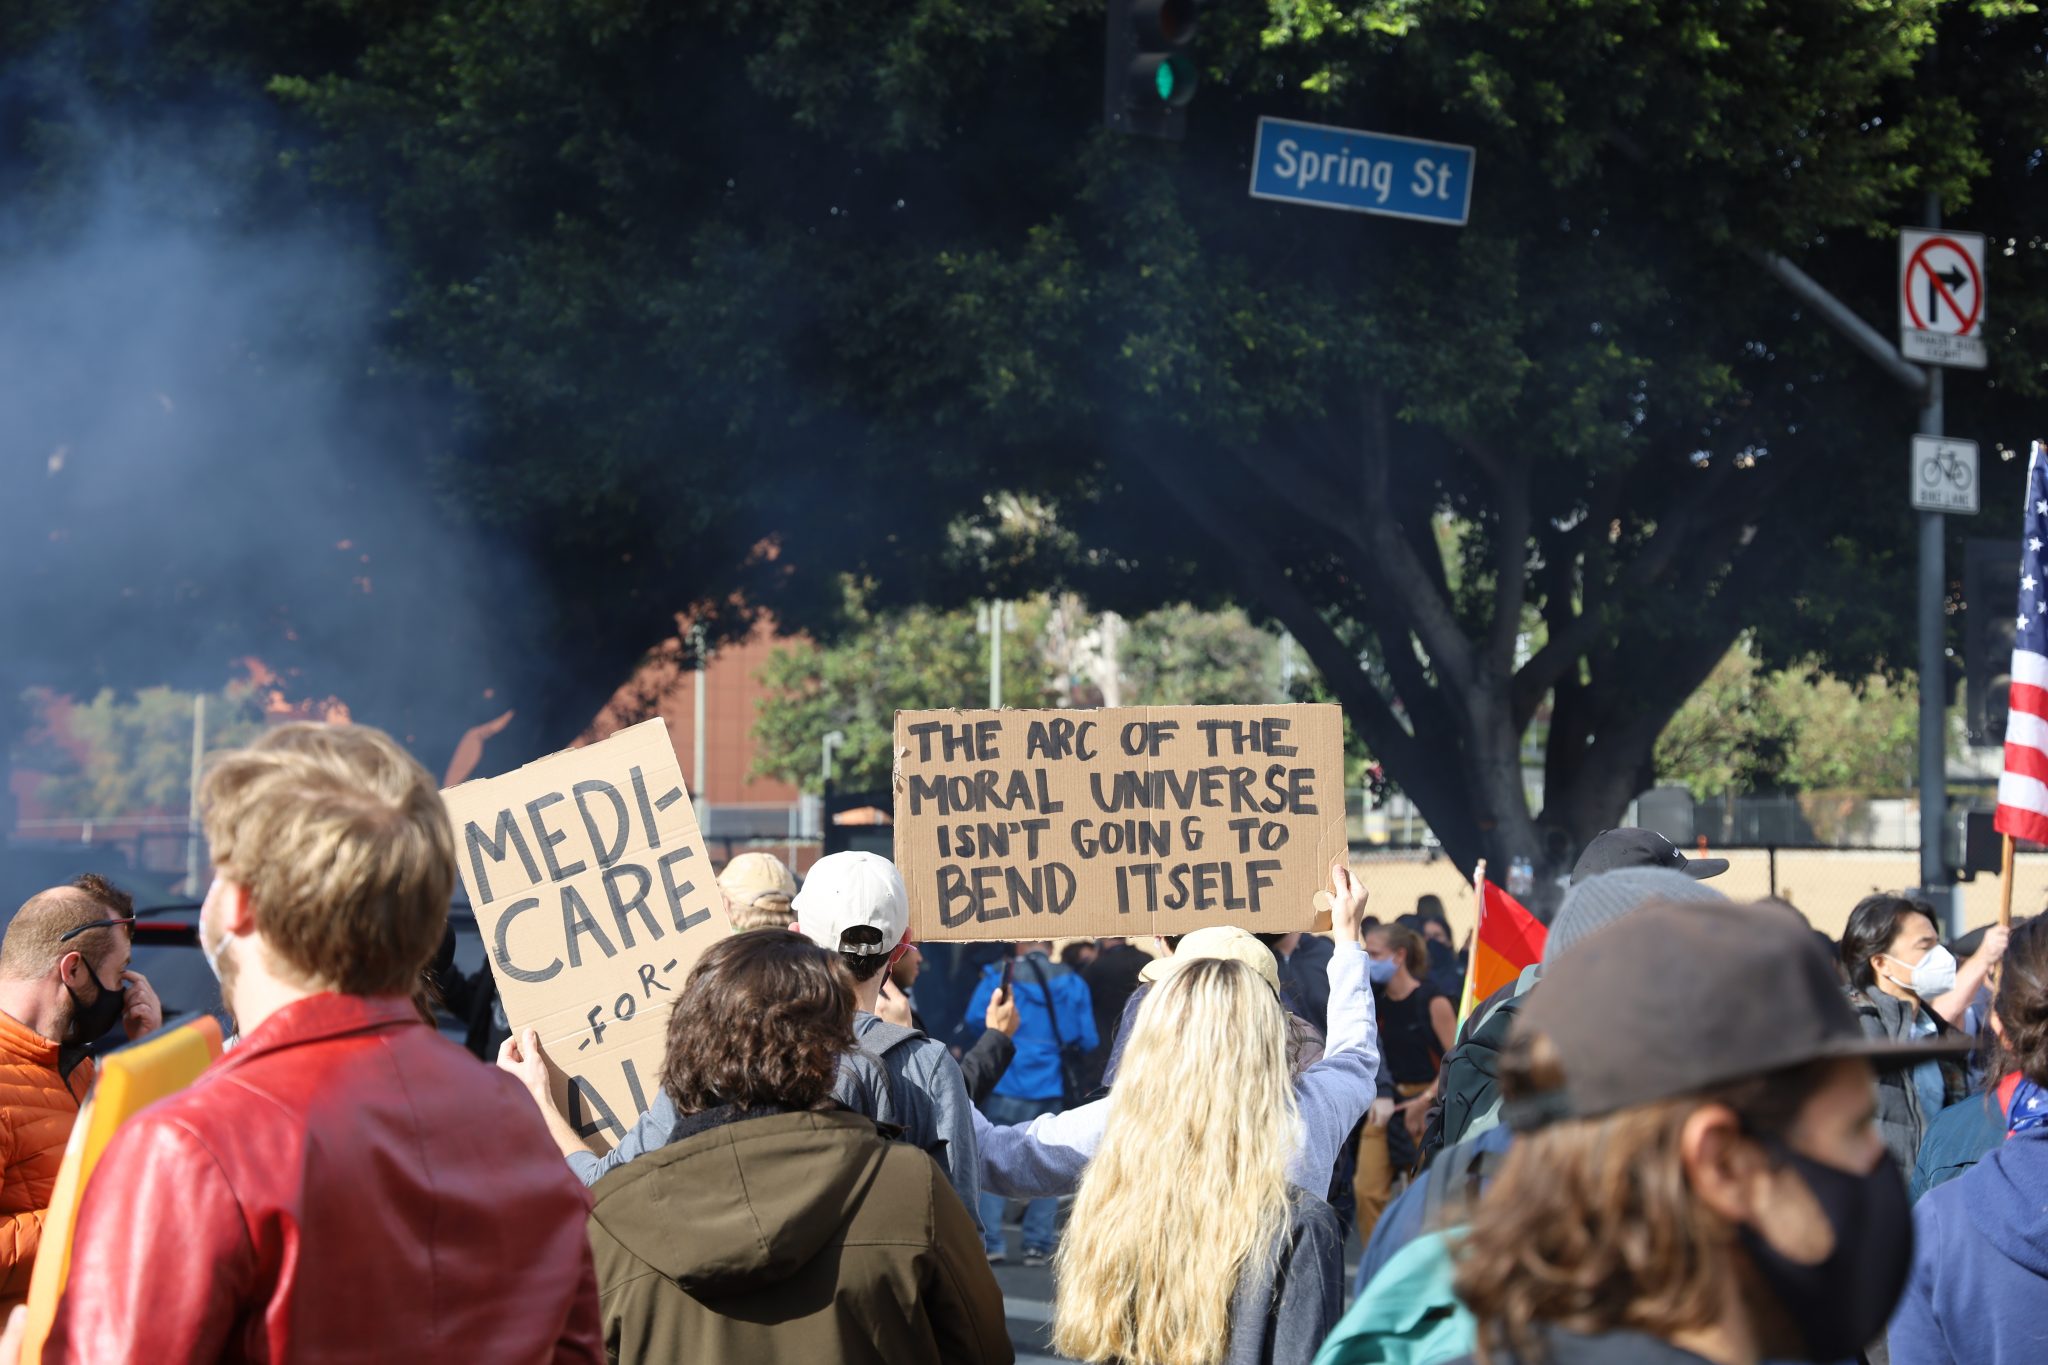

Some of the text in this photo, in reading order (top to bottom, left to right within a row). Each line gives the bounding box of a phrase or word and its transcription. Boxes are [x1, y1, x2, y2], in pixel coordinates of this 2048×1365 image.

[1273, 139, 1452, 204] Spring St
[908, 717, 1298, 762] THE ARC OF THE
[909, 764, 1318, 816] MORAL UNIVERSE
[465, 766, 683, 904] MEDI-
[937, 815, 1290, 860] ISN'T GOING TO
[493, 846, 711, 983] CARE
[936, 859, 1282, 928] BEND ITSELF
